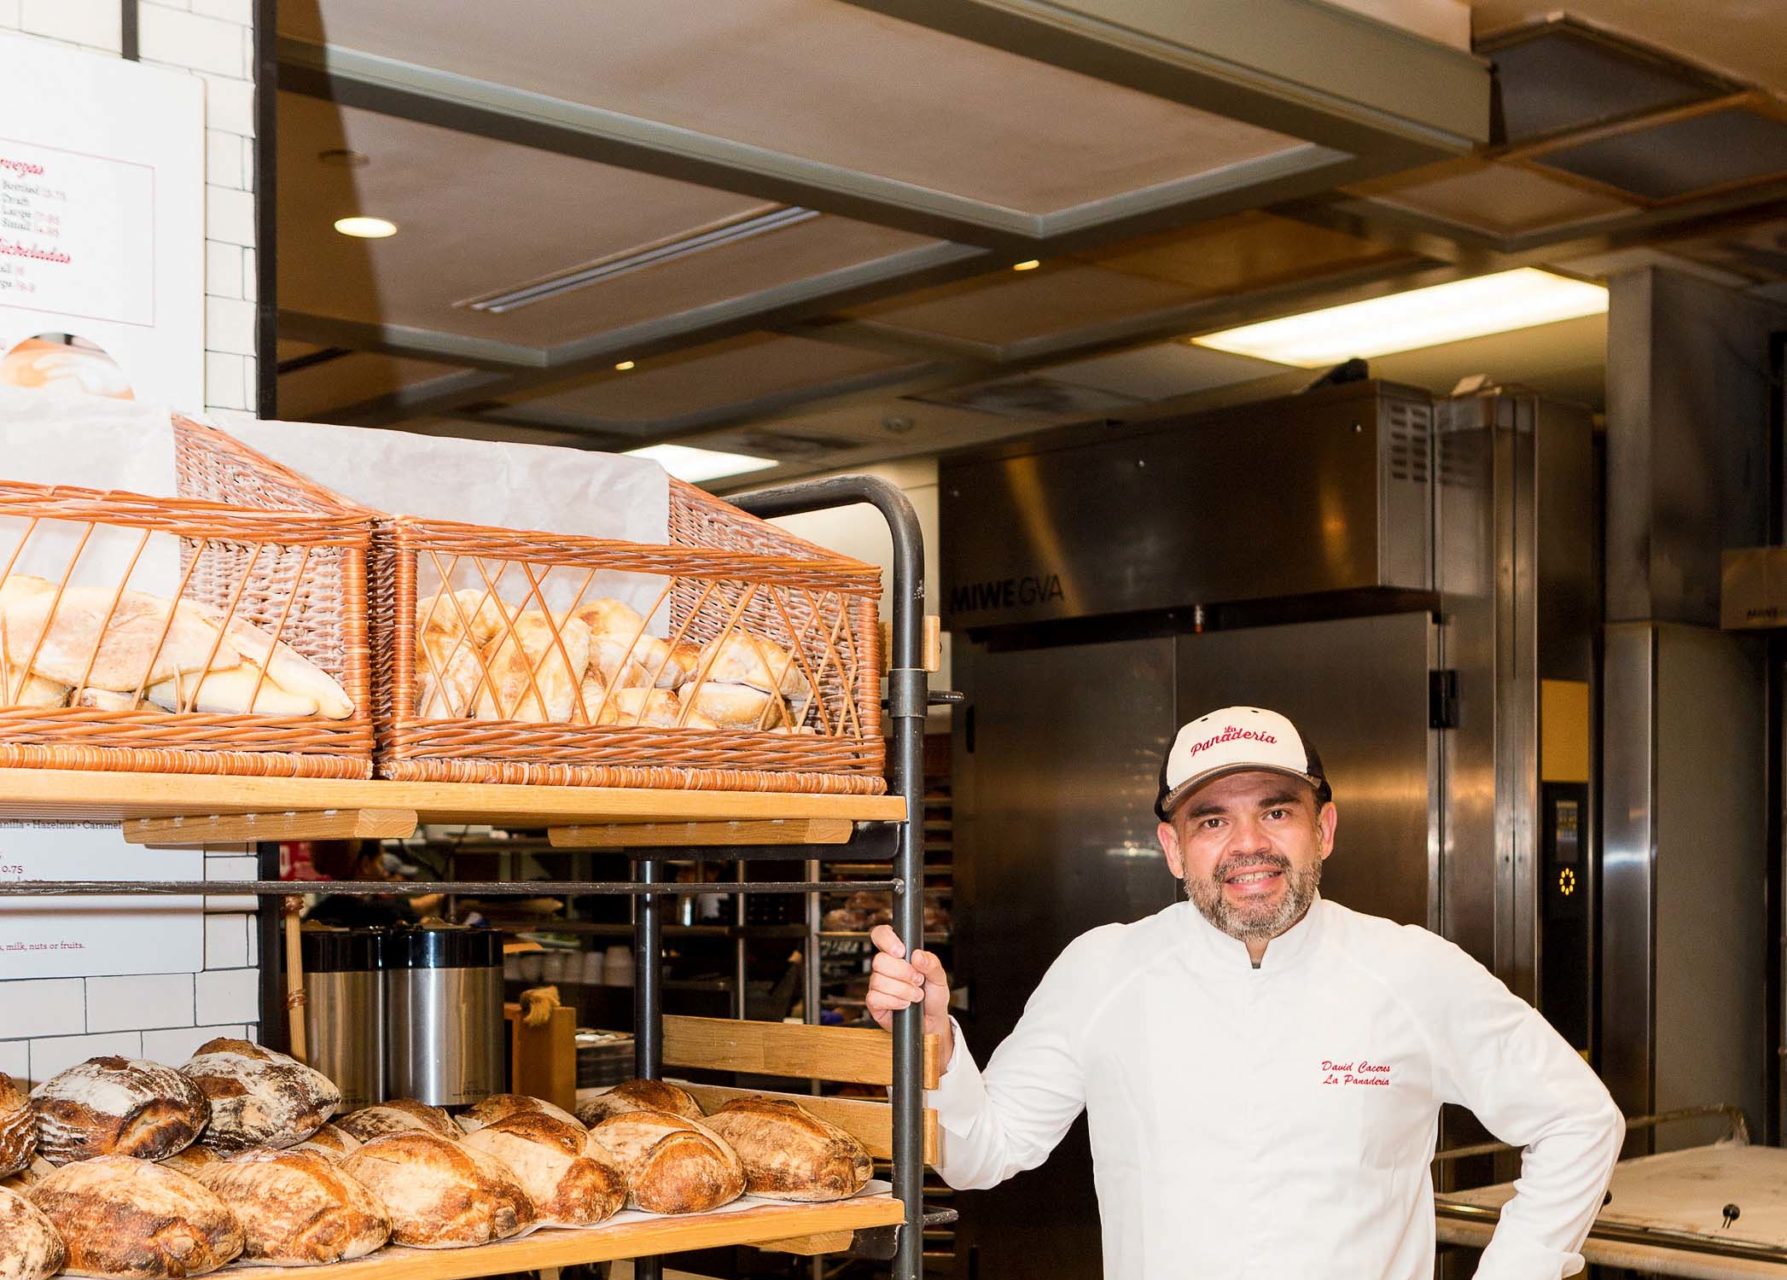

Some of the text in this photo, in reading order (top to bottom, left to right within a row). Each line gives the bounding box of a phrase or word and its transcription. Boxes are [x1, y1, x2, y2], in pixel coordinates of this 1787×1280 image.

[1, 865, 23, 874] 0.75
[29, 943, 48, 951] nuts
[49, 943, 59, 951] or
[1321, 1060, 1354, 1072] David
[1322, 1073, 1339, 1085] La
